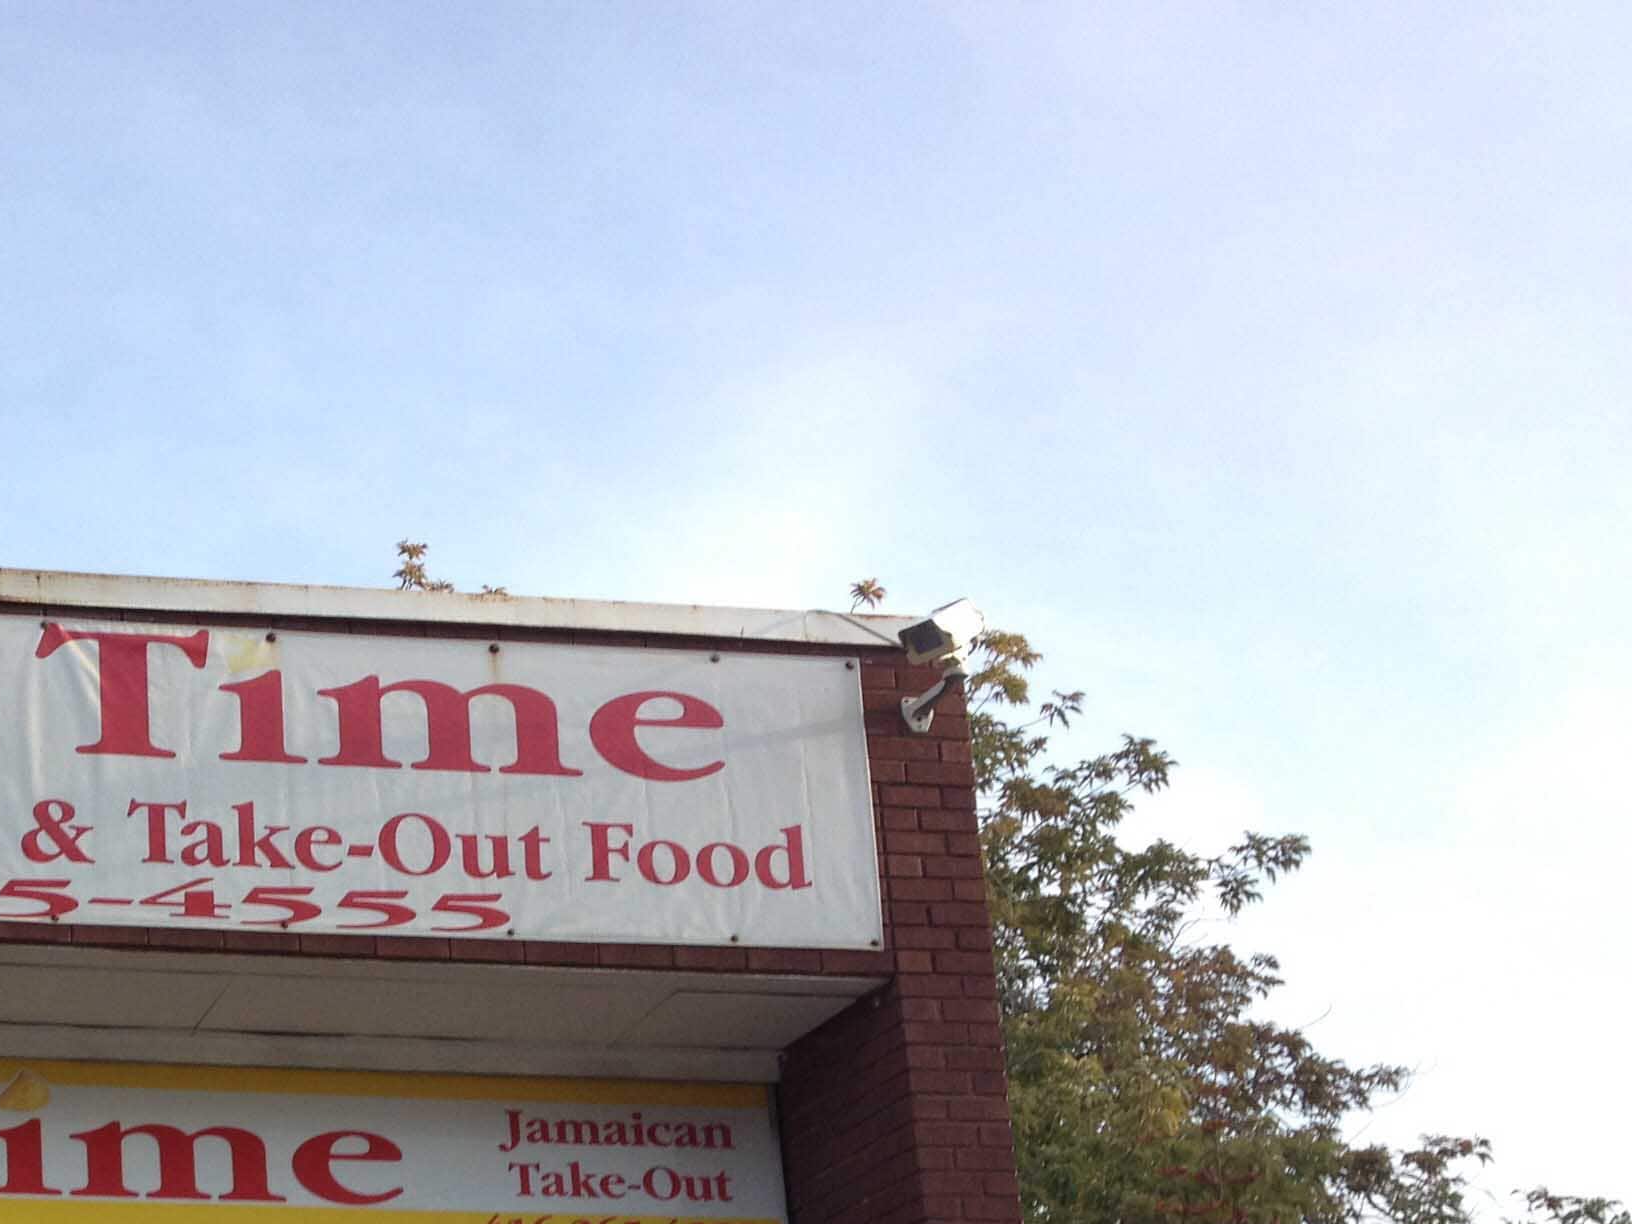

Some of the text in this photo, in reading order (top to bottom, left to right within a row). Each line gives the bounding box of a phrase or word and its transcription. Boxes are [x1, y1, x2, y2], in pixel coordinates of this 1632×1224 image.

[35, 621, 725, 783] Time
[21, 799, 95, 864] &
[127, 797, 552, 881] Take-Out
[582, 822, 813, 891] Food
[499, 1108, 737, 1152] Jamaican
[508, 1161, 734, 1202] Take-Out
